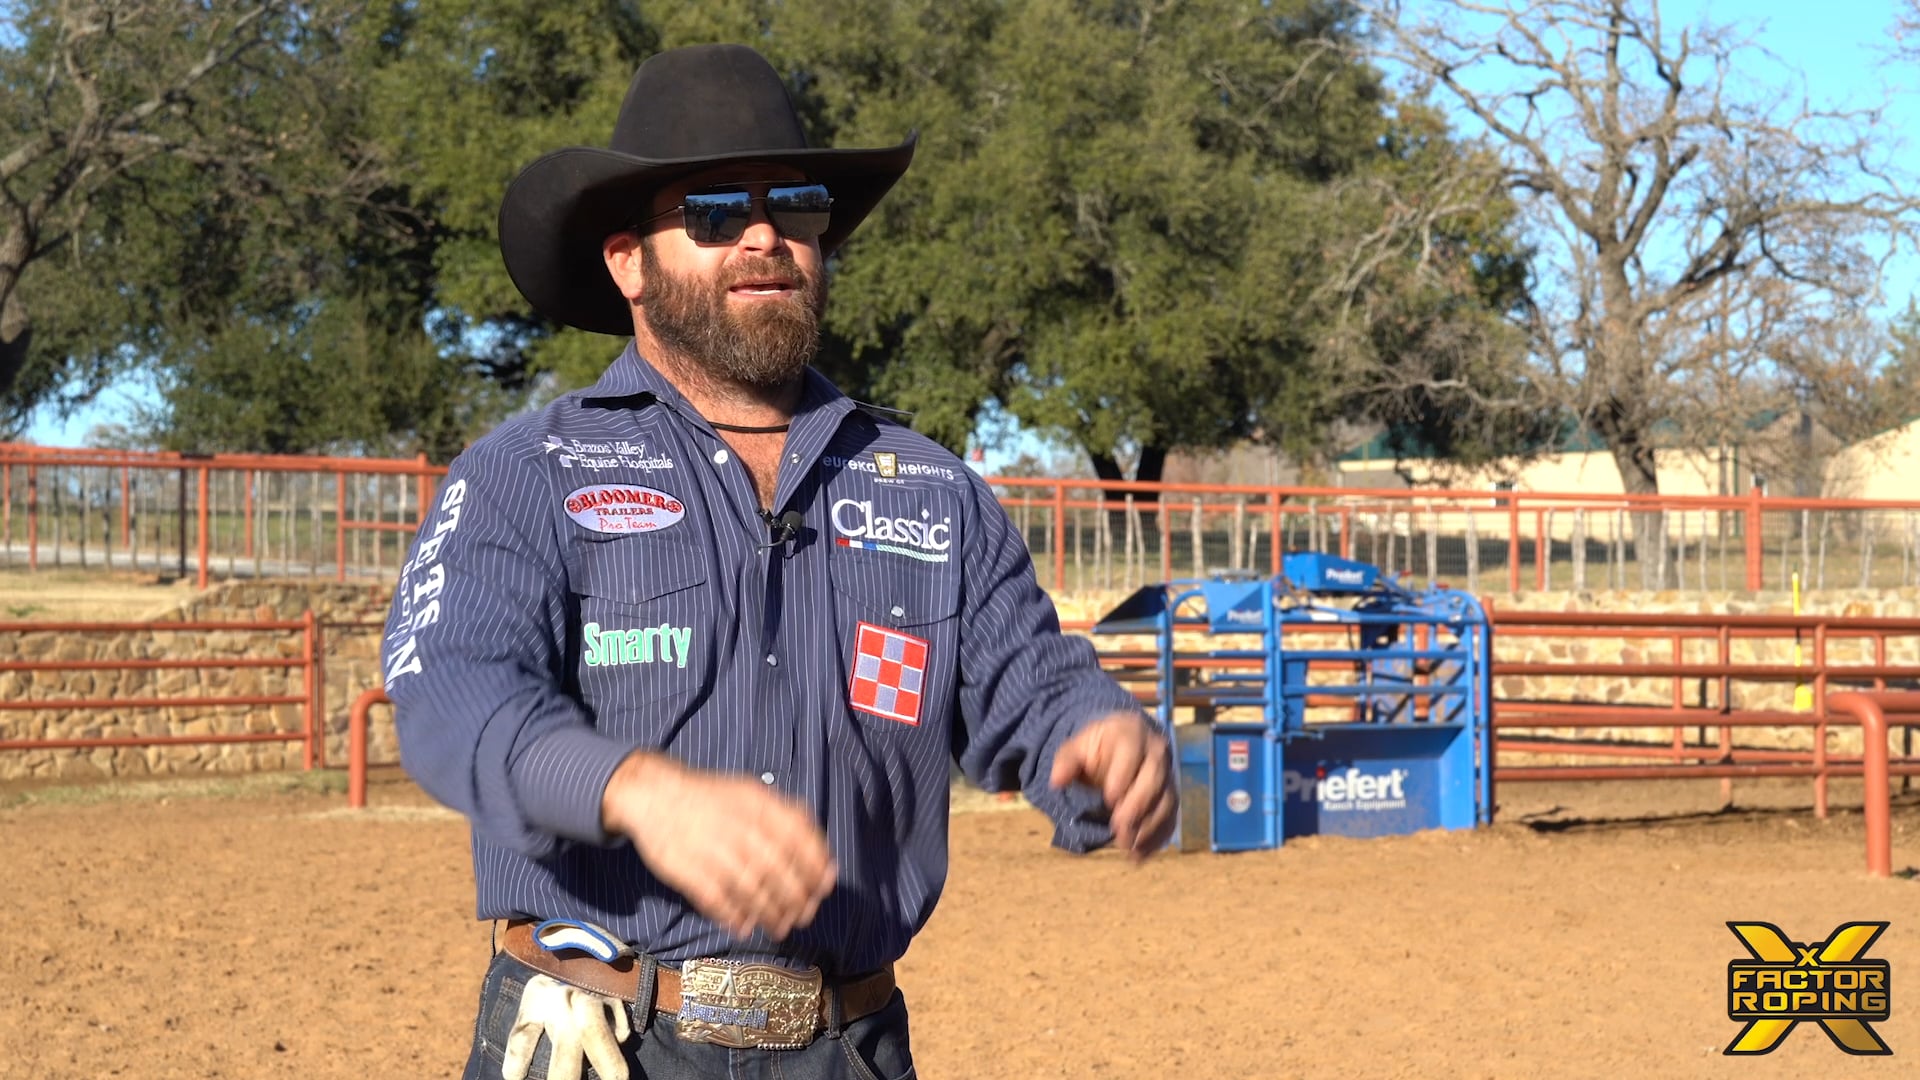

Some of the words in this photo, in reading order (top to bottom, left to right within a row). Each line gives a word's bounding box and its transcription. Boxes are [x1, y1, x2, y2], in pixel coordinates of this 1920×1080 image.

[571, 439, 612, 454] Brazos
[608, 440, 646, 458] Valley
[579, 453, 619, 472] Equine
[619, 452, 674, 473] Hospitals
[578, 489, 668, 513] BLOOMER
[594, 507, 654, 516] TRAILERS
[599, 517, 624, 532] Pro
[624, 517, 657, 529] Team
[831, 498, 950, 550] Classic
[385, 479, 466, 683] STETSN
[387, 559, 414, 641] BOOT
[584, 622, 692, 669] Smarty
[1284, 766, 1404, 801] Priefert
[1323, 799, 1352, 811] Ranch
[1355, 799, 1406, 812] Equipment
